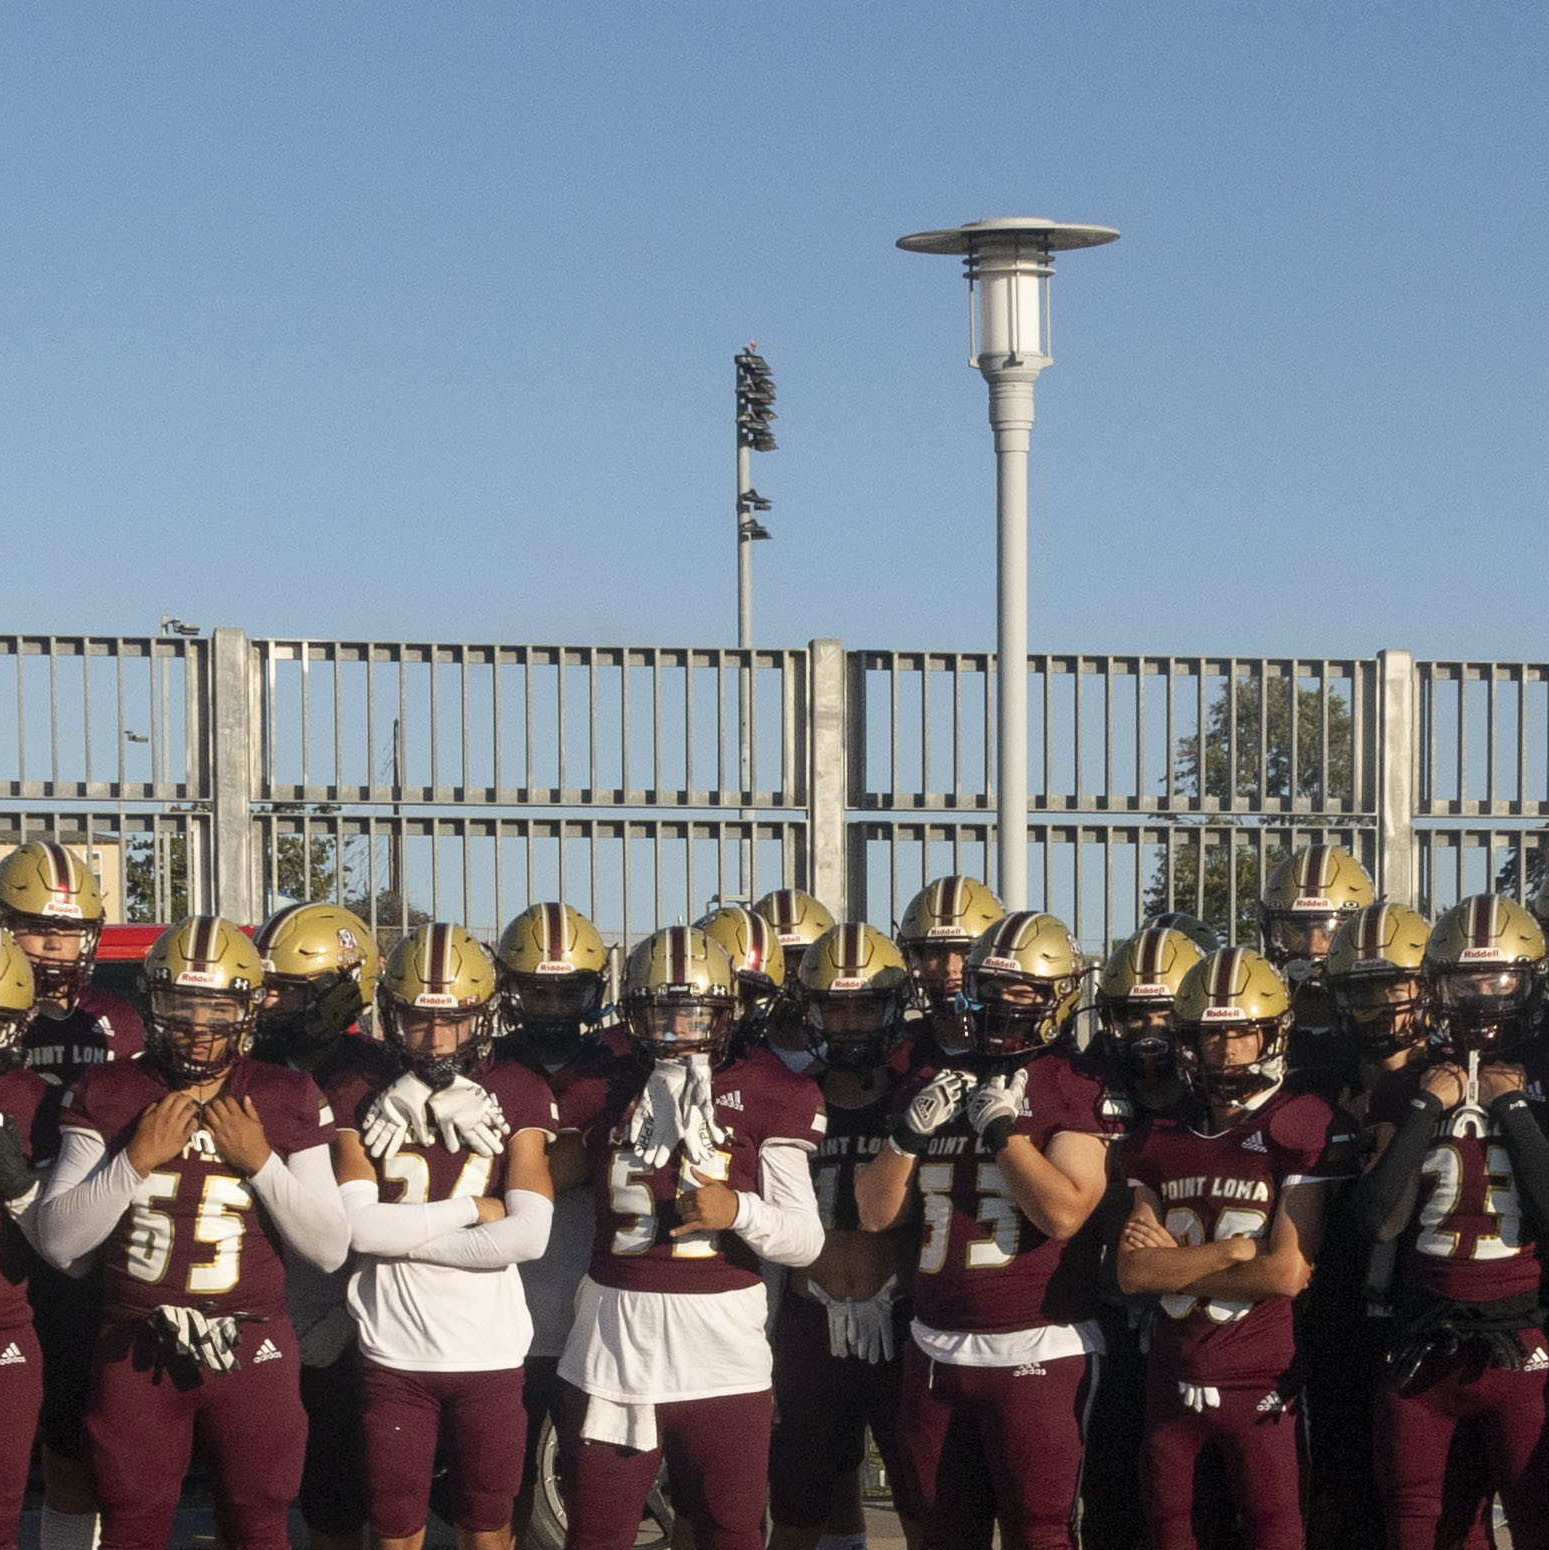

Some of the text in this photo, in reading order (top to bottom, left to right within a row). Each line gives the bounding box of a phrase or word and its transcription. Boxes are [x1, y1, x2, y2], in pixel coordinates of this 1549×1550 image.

[1296, 899, 1328, 907] Riddell
[49, 905, 78, 914] Riddell
[931, 928, 961, 936] Riddell
[1464, 949, 1499, 959] Riddell
[541, 964, 571, 972] Riddell
[985, 958, 1016, 969] Riddell
[182, 974, 214, 983] Riddell
[420, 997, 452, 1005] Riddell
[1206, 1009, 1239, 1018] Riddell
[1211, 1176, 1269, 1202] LOMA
[1415, 1142, 1523, 1261] 23
[0, 1355, 27, 1366] adidas
[253, 1350, 282, 1363] adidas
[1013, 1368, 1046, 1377] adidas
